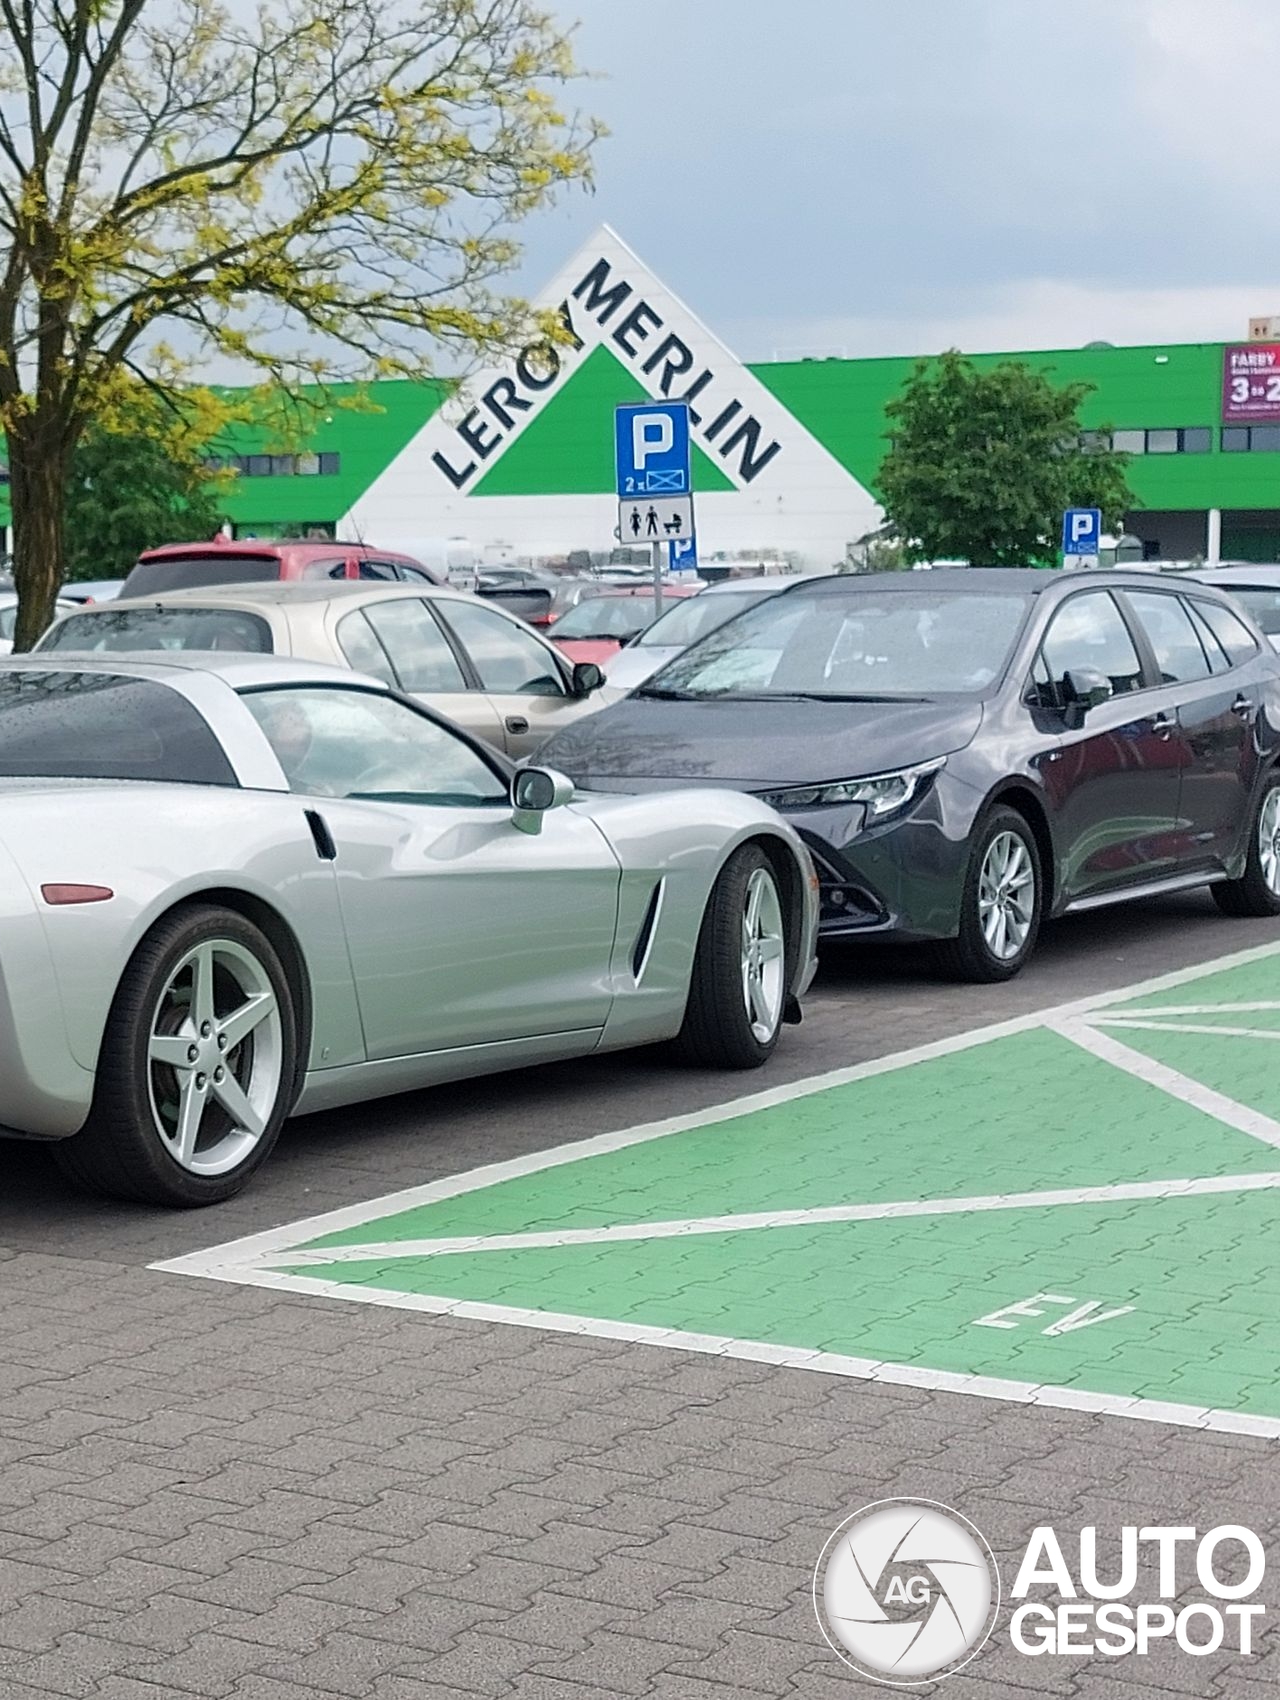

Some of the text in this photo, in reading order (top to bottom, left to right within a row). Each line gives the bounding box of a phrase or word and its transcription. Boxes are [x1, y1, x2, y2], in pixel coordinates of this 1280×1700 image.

[430, 256, 783, 490] LEROY MERLIN
[1230, 376, 1250, 403] 3
[632, 413, 674, 470] P
[625, 476, 635, 492] 2
[1072, 514, 1093, 542] P
[674, 539, 692, 559] P
[971, 1292, 1138, 1337] EV
